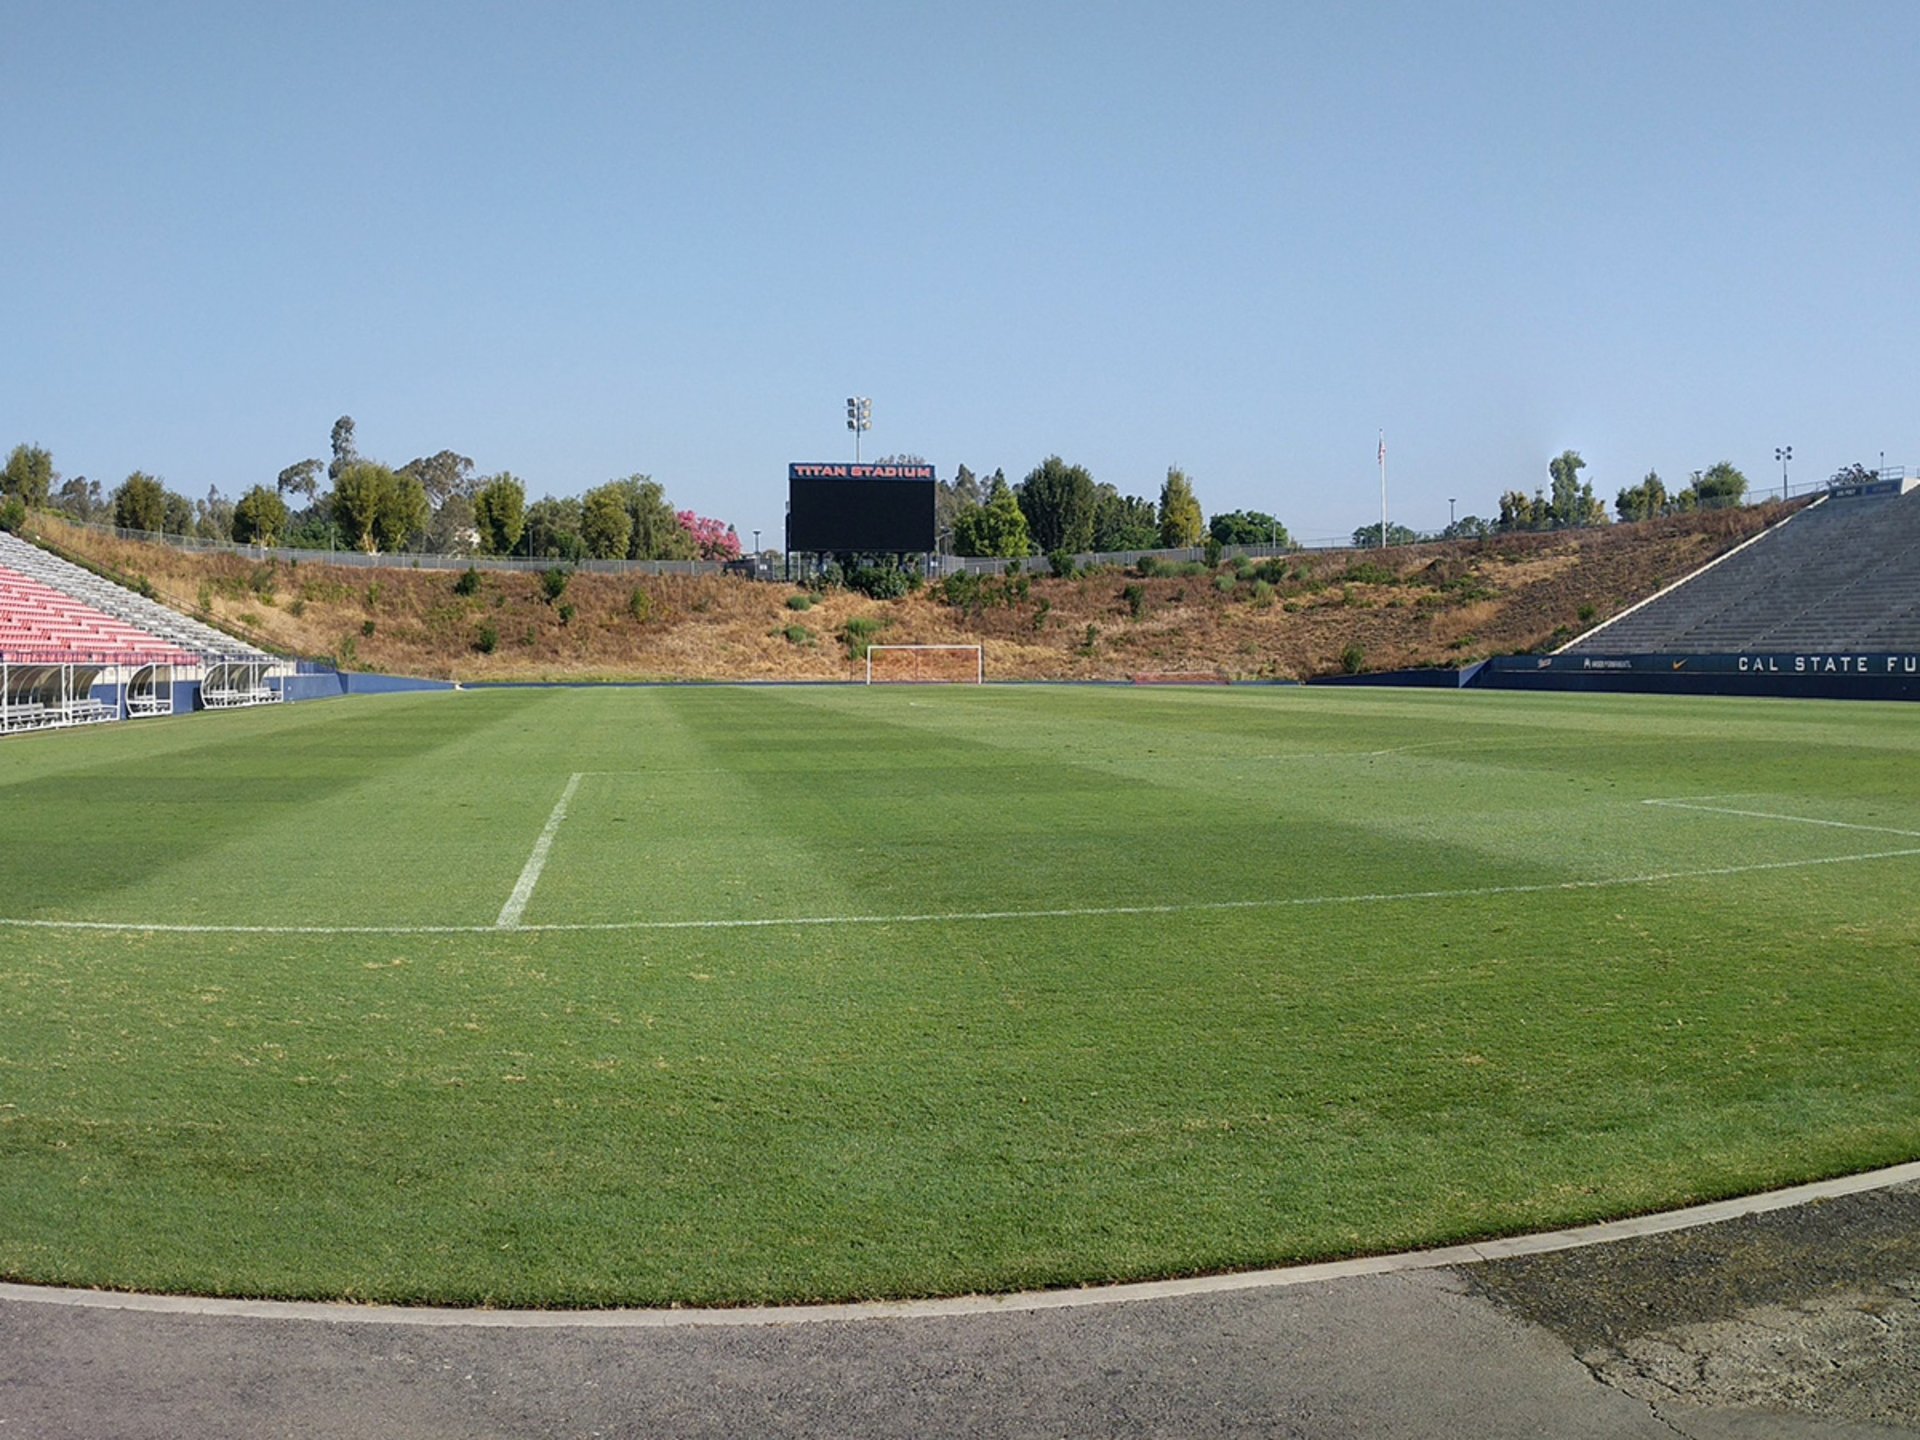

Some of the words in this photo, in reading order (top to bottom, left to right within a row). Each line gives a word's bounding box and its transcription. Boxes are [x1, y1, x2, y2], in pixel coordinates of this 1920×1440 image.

[795, 465, 847, 477] TITAN
[851, 466, 931, 478] STADIUM
[1738, 656, 1779, 672] CAL
[1795, 656, 1868, 672] STATE
[1887, 656, 1917, 672] FU
